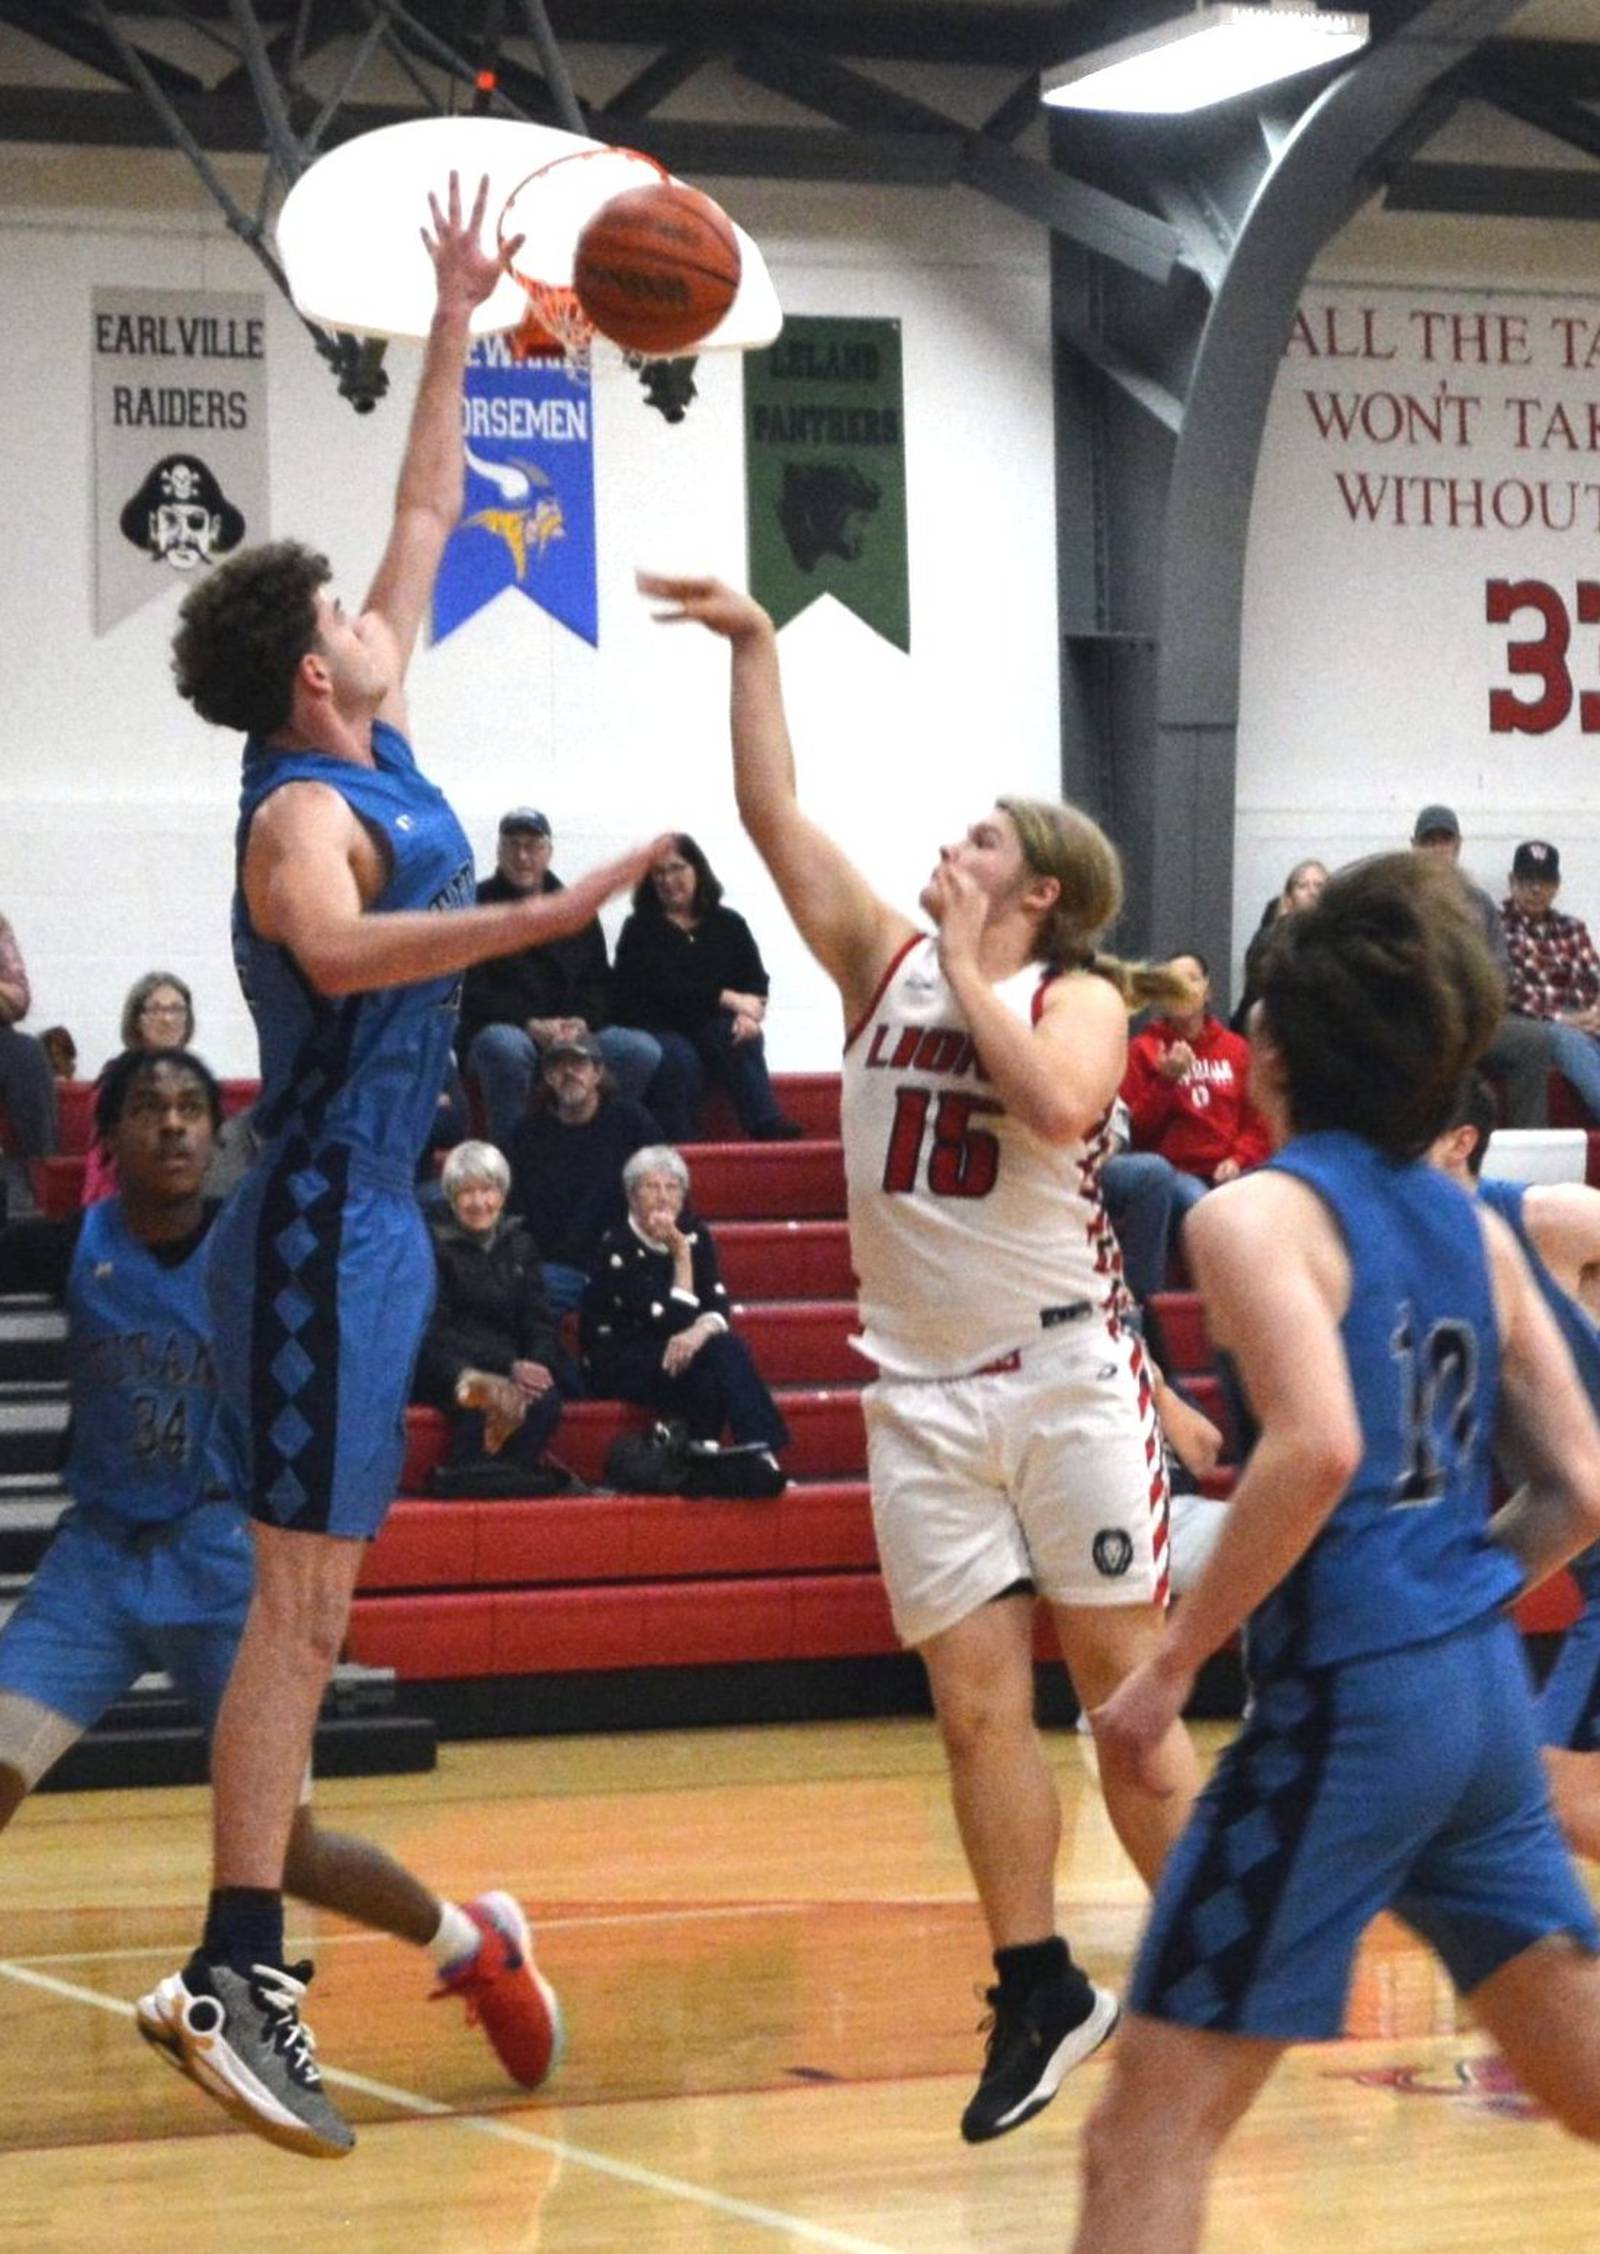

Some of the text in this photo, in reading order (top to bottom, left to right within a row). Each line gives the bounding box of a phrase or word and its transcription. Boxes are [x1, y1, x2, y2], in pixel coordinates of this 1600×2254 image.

[97, 314, 264, 359] EARLVILLE
[1284, 307, 1399, 358] ALL
[1409, 311, 1533, 364] THE
[113, 386, 248, 429] RAIDERS
[462, 397, 588, 440] ORSEMEN
[752, 404, 899, 446] PANTHERS
[1303, 379, 1480, 447] WON'T
[1486, 579, 1600, 735] 3
[865, 1024, 992, 1083] LION
[882, 1085, 1006, 1197] 15
